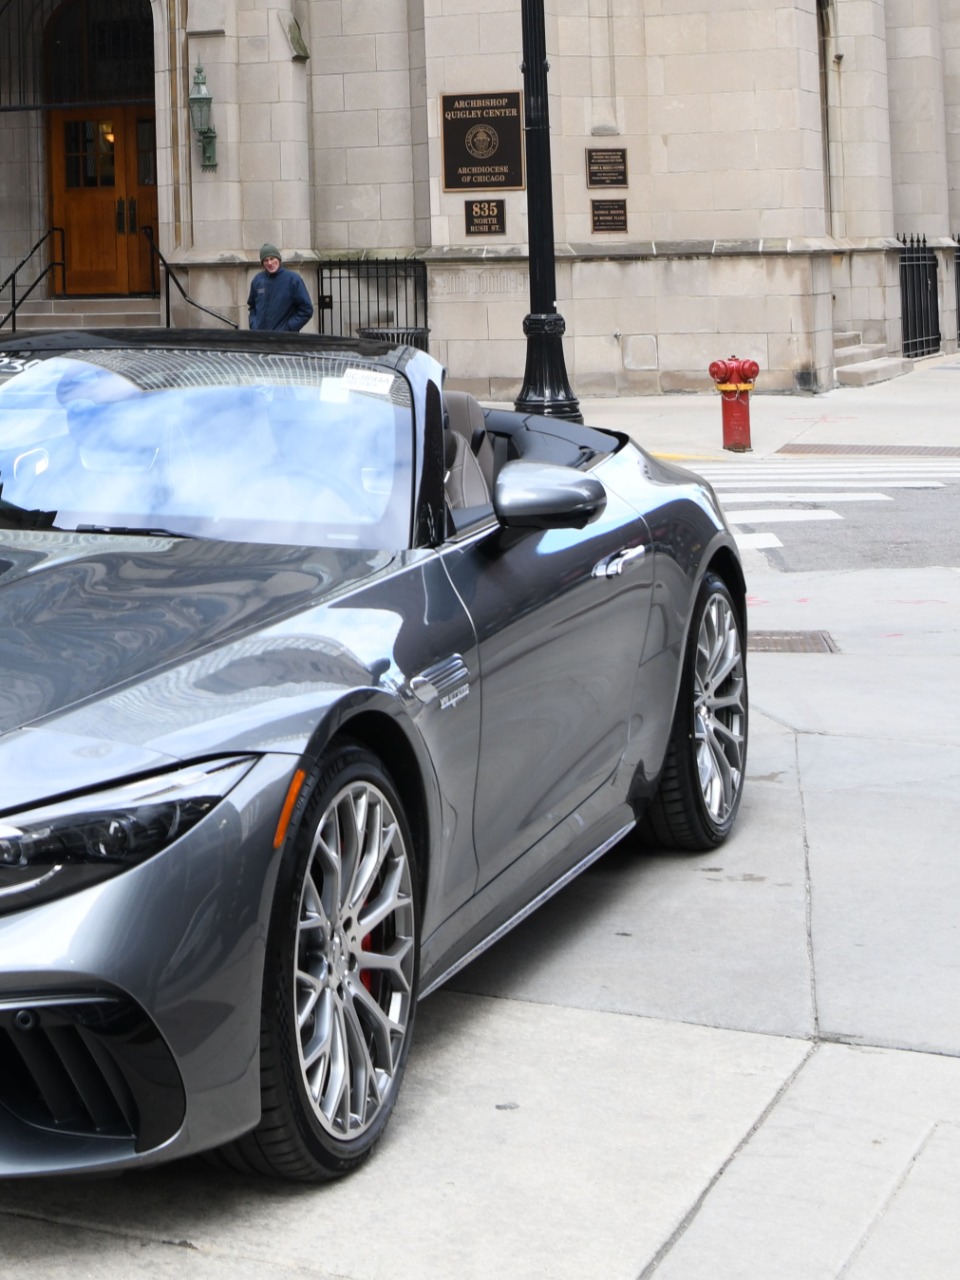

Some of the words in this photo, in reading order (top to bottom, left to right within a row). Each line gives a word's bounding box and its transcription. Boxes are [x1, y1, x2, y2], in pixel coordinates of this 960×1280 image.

[453, 98, 508, 109] ARCHBISHOP
[445, 110, 482, 120] QUIGLEY
[483, 108, 518, 118] CENTER
[457, 165, 509, 174] ARCHDIOCESE
[461, 175, 472, 183] OF
[472, 174, 505, 183] CHICAGO
[472, 202, 498, 217] 835
